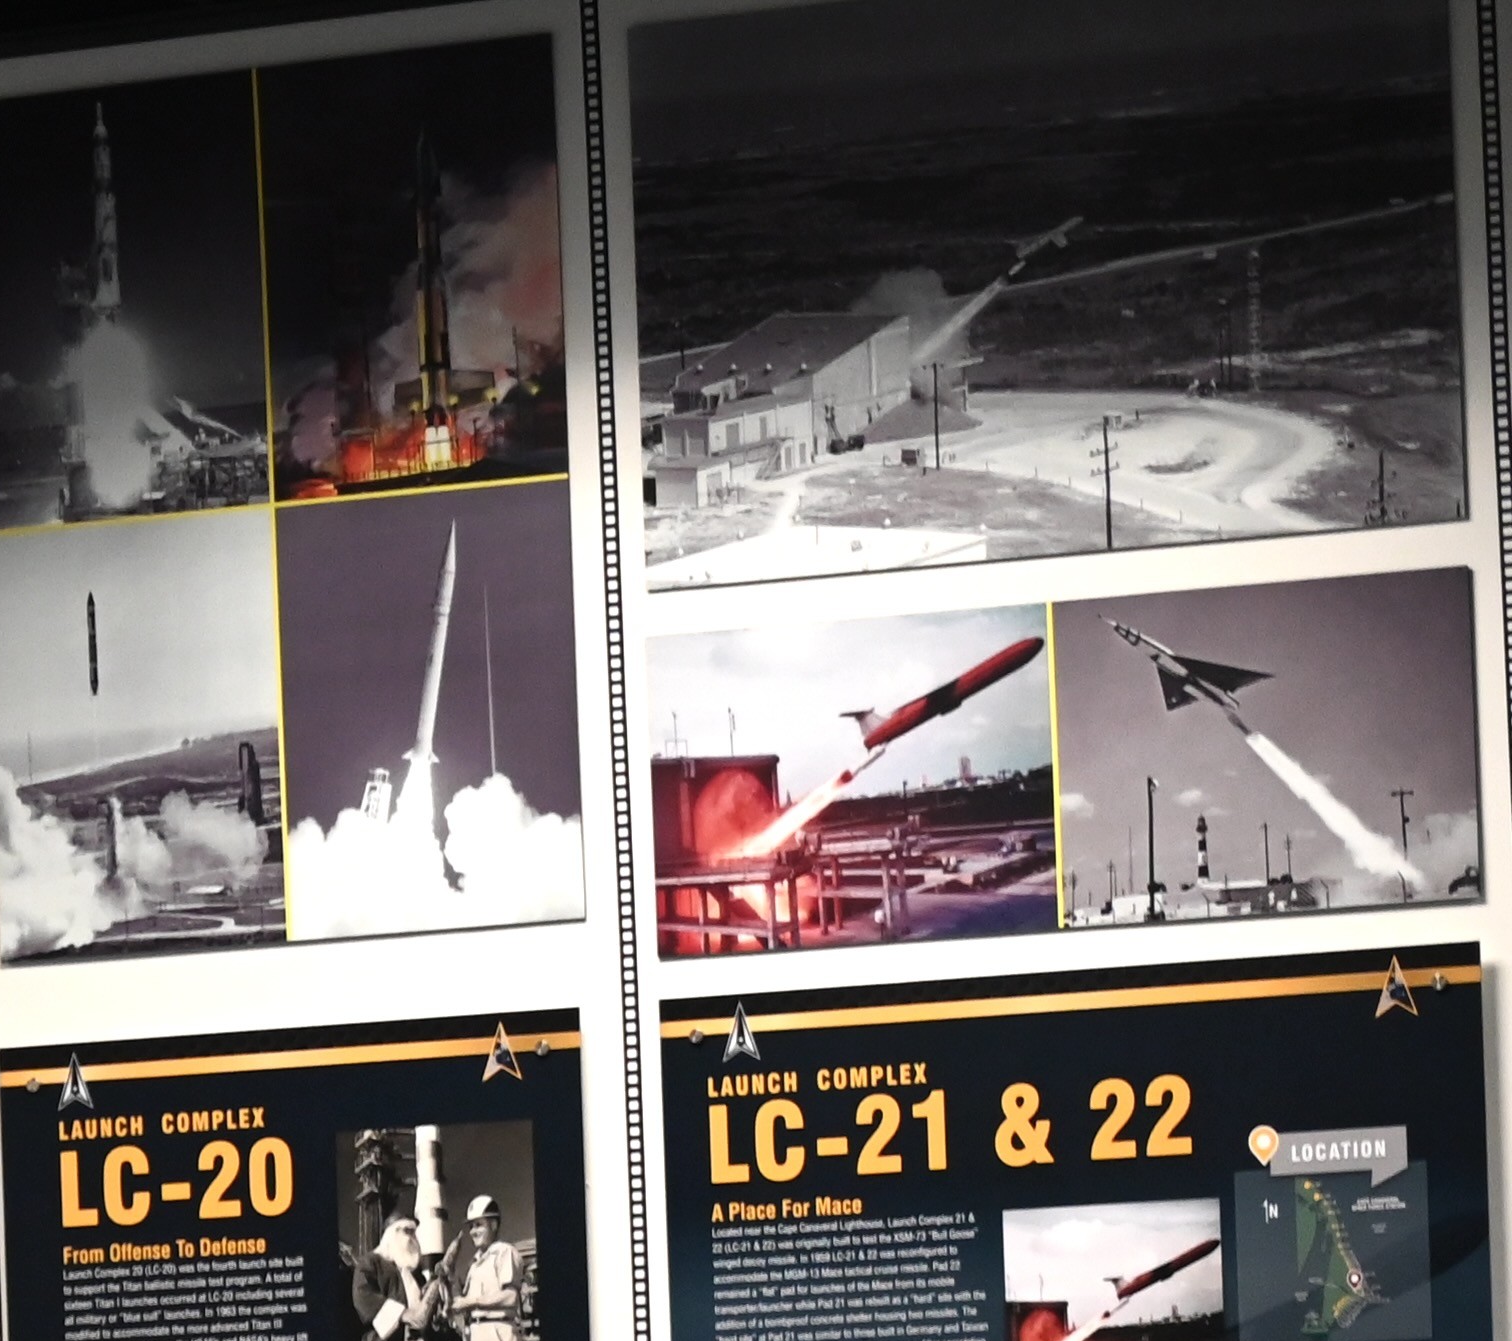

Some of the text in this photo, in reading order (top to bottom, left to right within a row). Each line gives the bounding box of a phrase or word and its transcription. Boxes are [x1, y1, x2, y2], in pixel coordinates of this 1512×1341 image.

[707, 1064, 926, 1097] LAUNCH COMPLEX
[58, 1108, 264, 1140] LAUNCH COMPLEX
[708, 1074, 1194, 1185] LC-21 & 22
[1291, 1139, 1387, 1163] LOCATION
[61, 1137, 294, 1228] LC-20
[712, 1196, 863, 1223] A Place For Mace
[1269, 1203, 1279, 1219] N
[63, 1237, 267, 1265] From Offense To Defense
[62, 1269, 93, 1280] Launch
[93, 1267, 130, 1278] Complex
